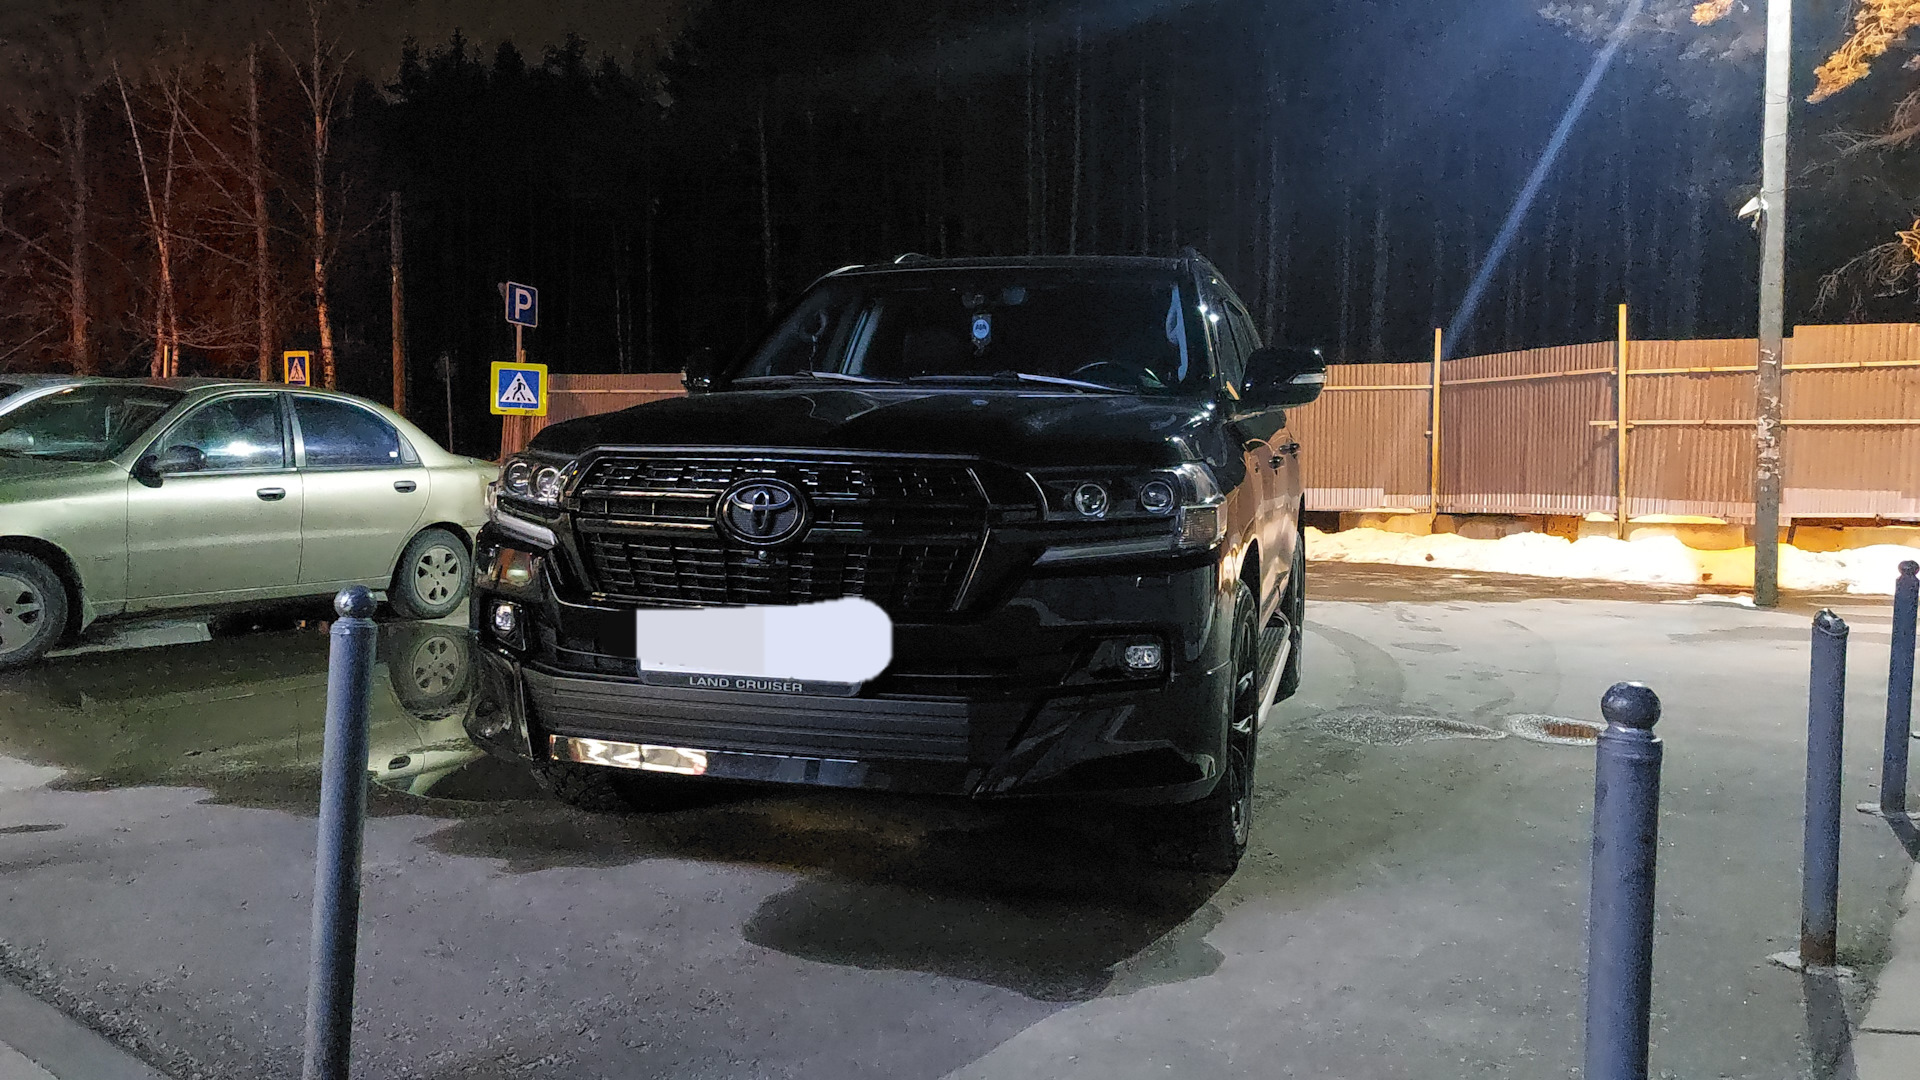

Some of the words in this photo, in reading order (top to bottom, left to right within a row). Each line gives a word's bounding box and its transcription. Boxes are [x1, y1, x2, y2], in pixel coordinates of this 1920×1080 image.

[515, 288, 532, 319] P
[689, 676, 730, 688] LAND
[735, 679, 803, 693] CRUISER
